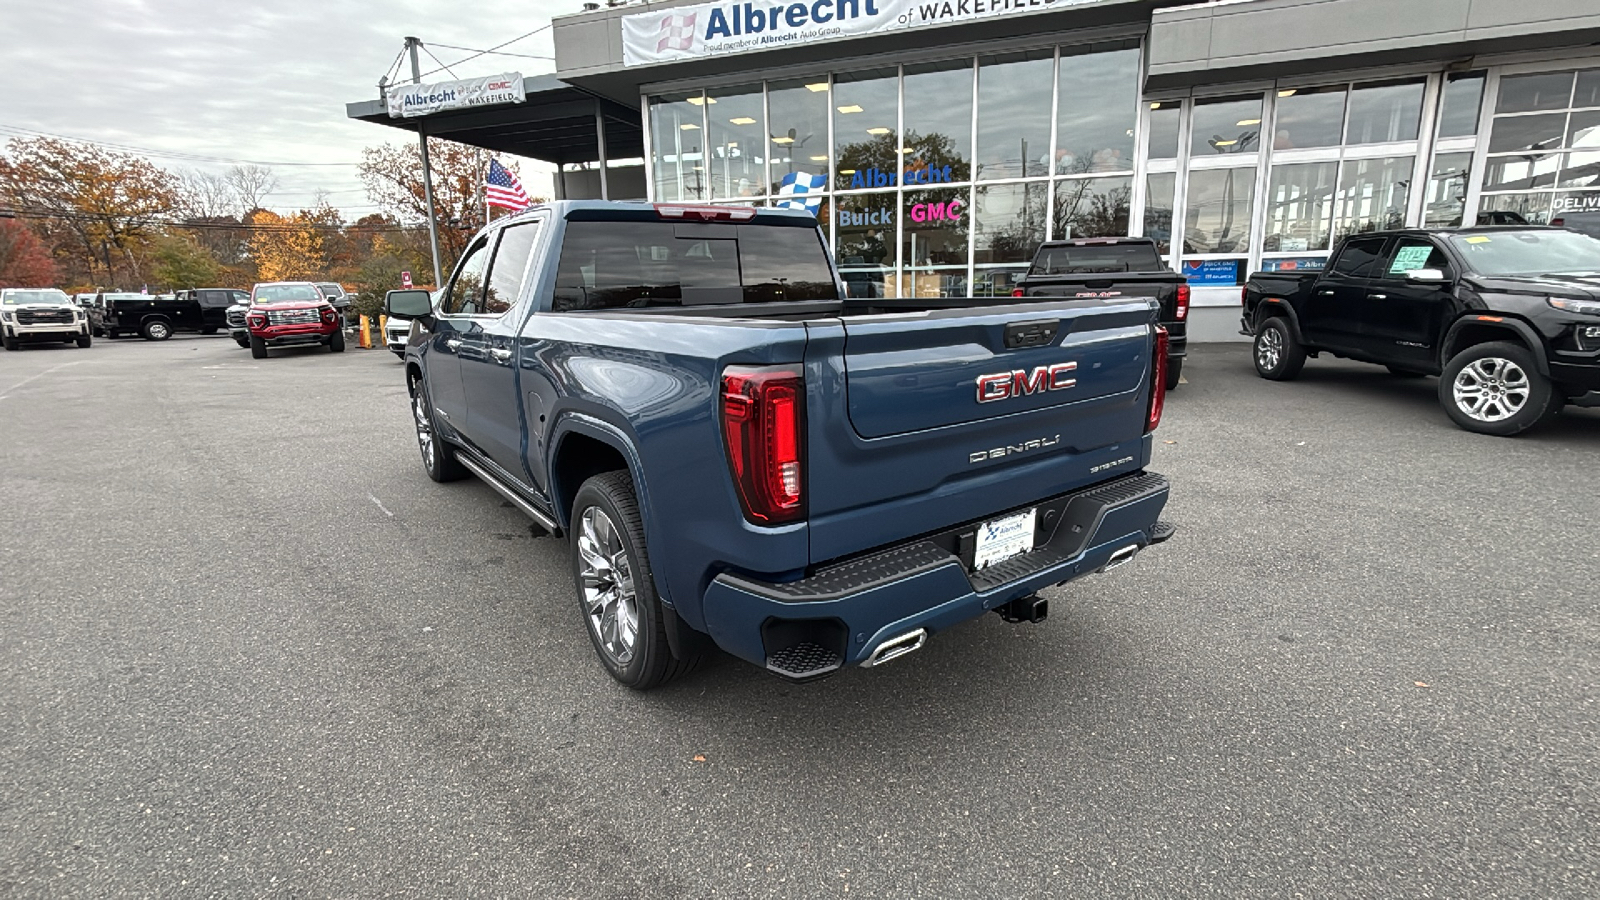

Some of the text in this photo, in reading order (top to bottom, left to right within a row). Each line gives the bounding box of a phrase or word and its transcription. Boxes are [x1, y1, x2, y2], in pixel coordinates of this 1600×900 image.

[705, 0, 878, 40] Albrecht
[898, 8, 913, 27] of
[703, 26, 841, 52] Proud member of Albrecht Auto Group
[404, 90, 456, 106] Albrecht
[488, 81, 512, 90] GMC
[467, 93, 514, 106] WAKEFIELD
[851, 163, 952, 189] Albrecht
[839, 201, 961, 227] Buick GMC
[976, 361, 1078, 404] GMC
[969, 434, 1060, 464] DENALI
